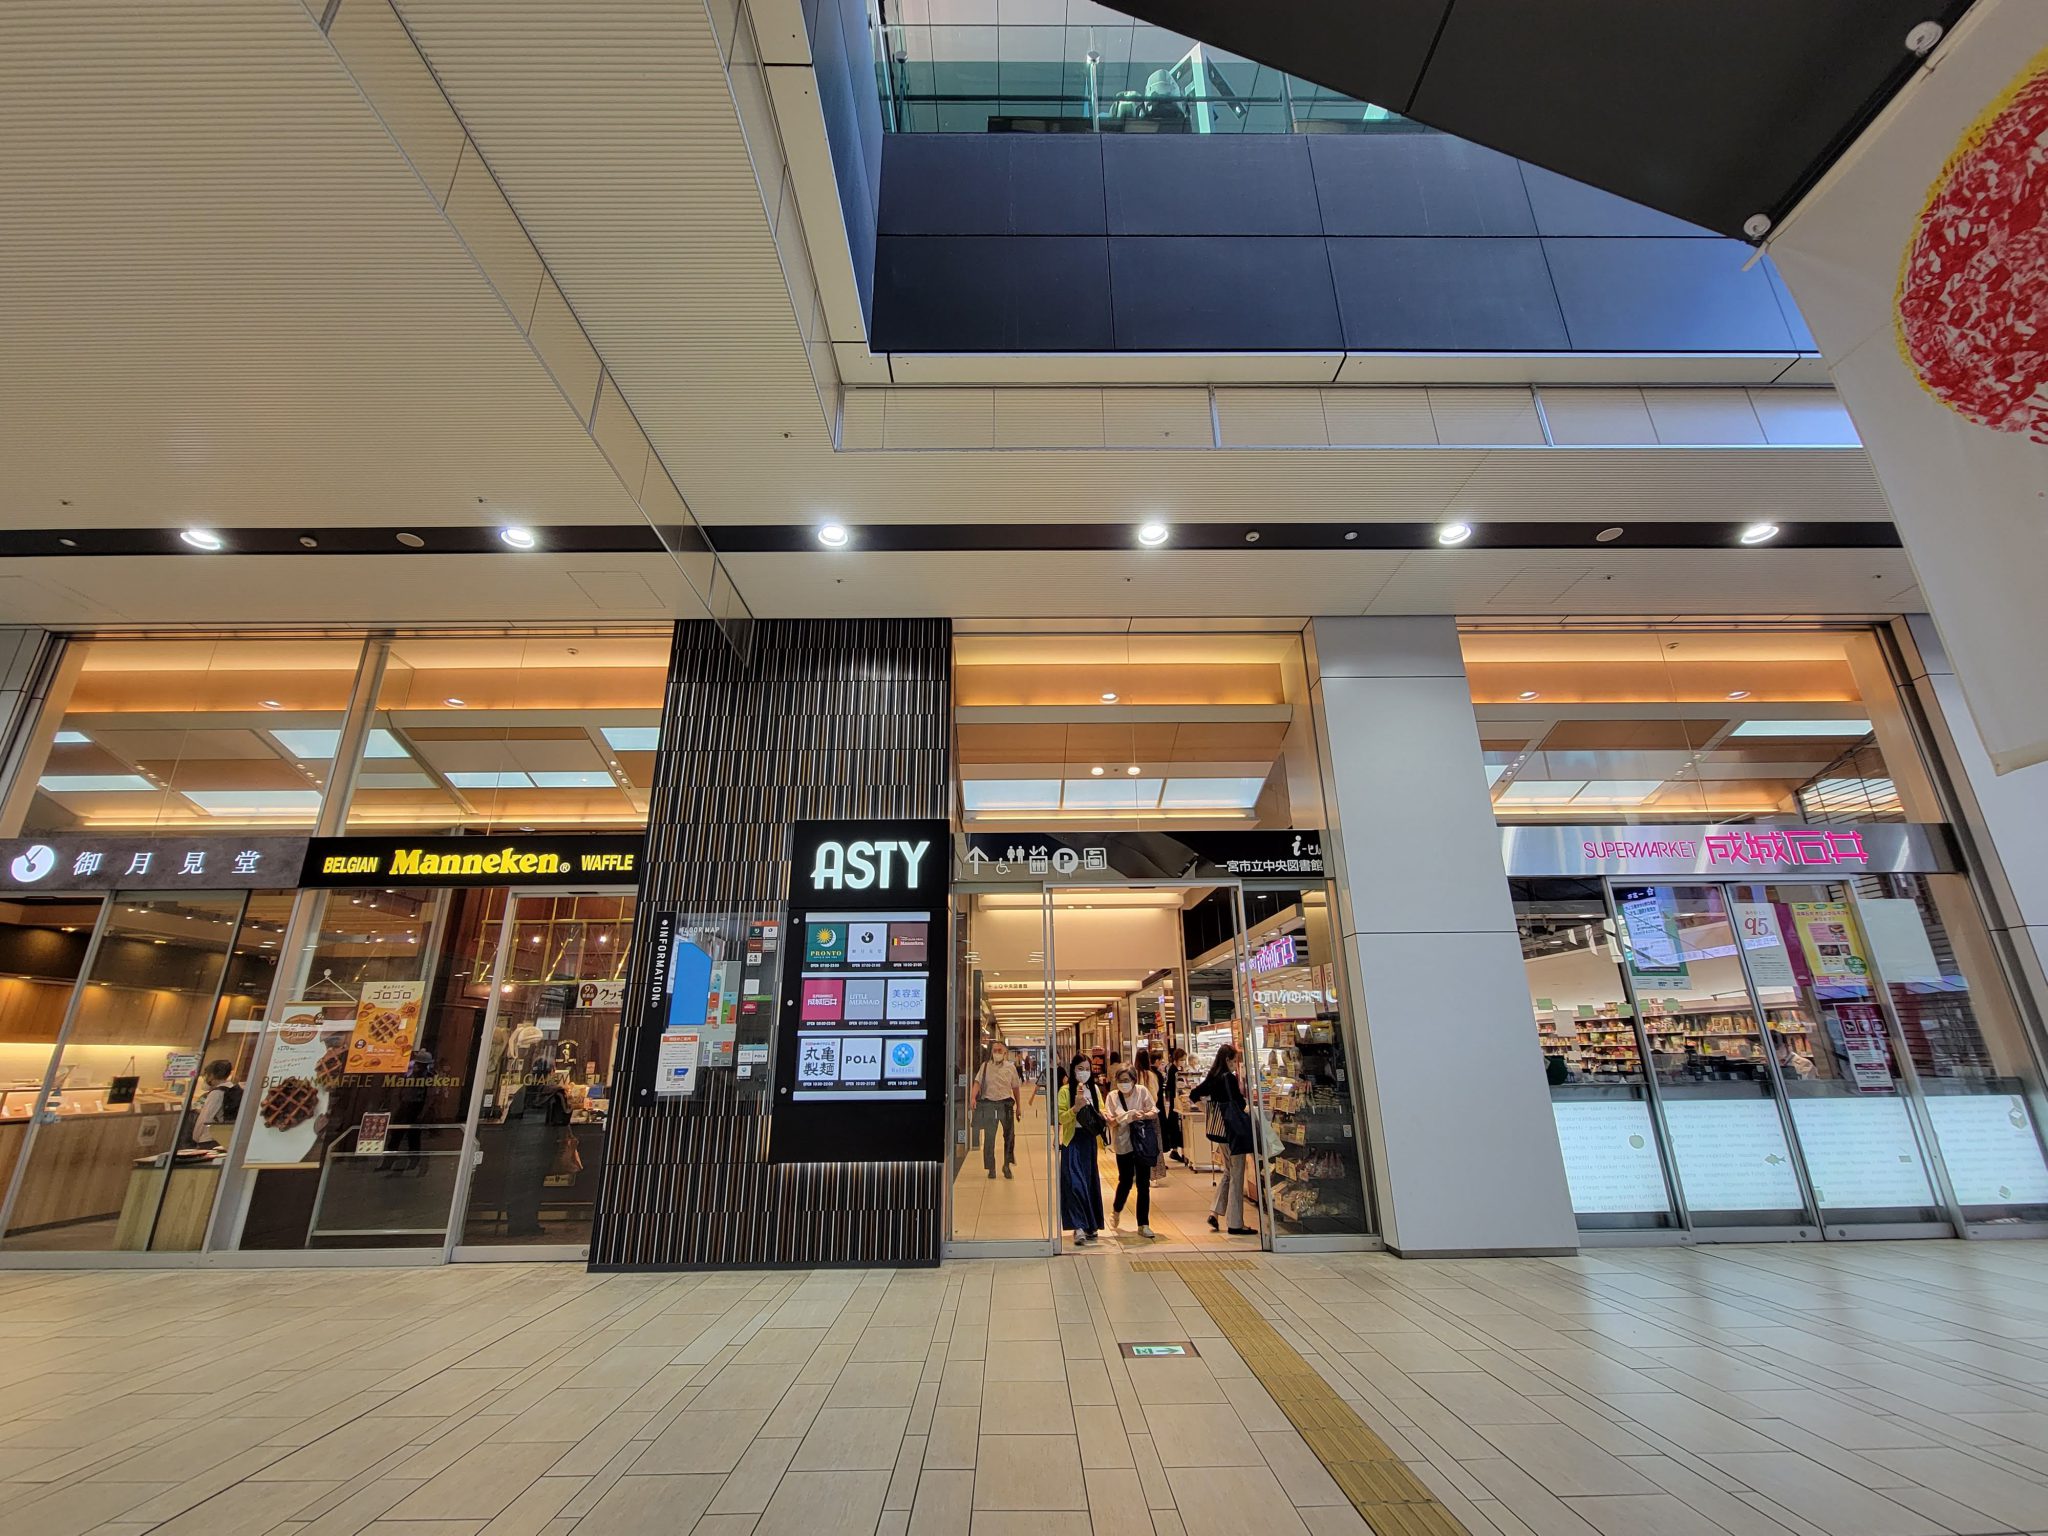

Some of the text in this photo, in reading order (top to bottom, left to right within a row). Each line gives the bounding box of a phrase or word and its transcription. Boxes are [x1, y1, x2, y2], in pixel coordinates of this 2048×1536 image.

[1583, 830, 1869, 865] SUPERMARKET 成城石井
[322, 856, 378, 873] BELGIAN
[581, 854, 634, 871] WAFFLE
[810, 841, 930, 889] ASTY
[1215, 859, 1323, 872] 一宮市立中央図書館
[651, 926, 669, 1001] INFORMATION
[892, 988, 921, 998] 美容室
[804, 1046, 835, 1062] 丸亀
[845, 1055, 877, 1064] POLA
[382, 1074, 461, 1088] Manneken
